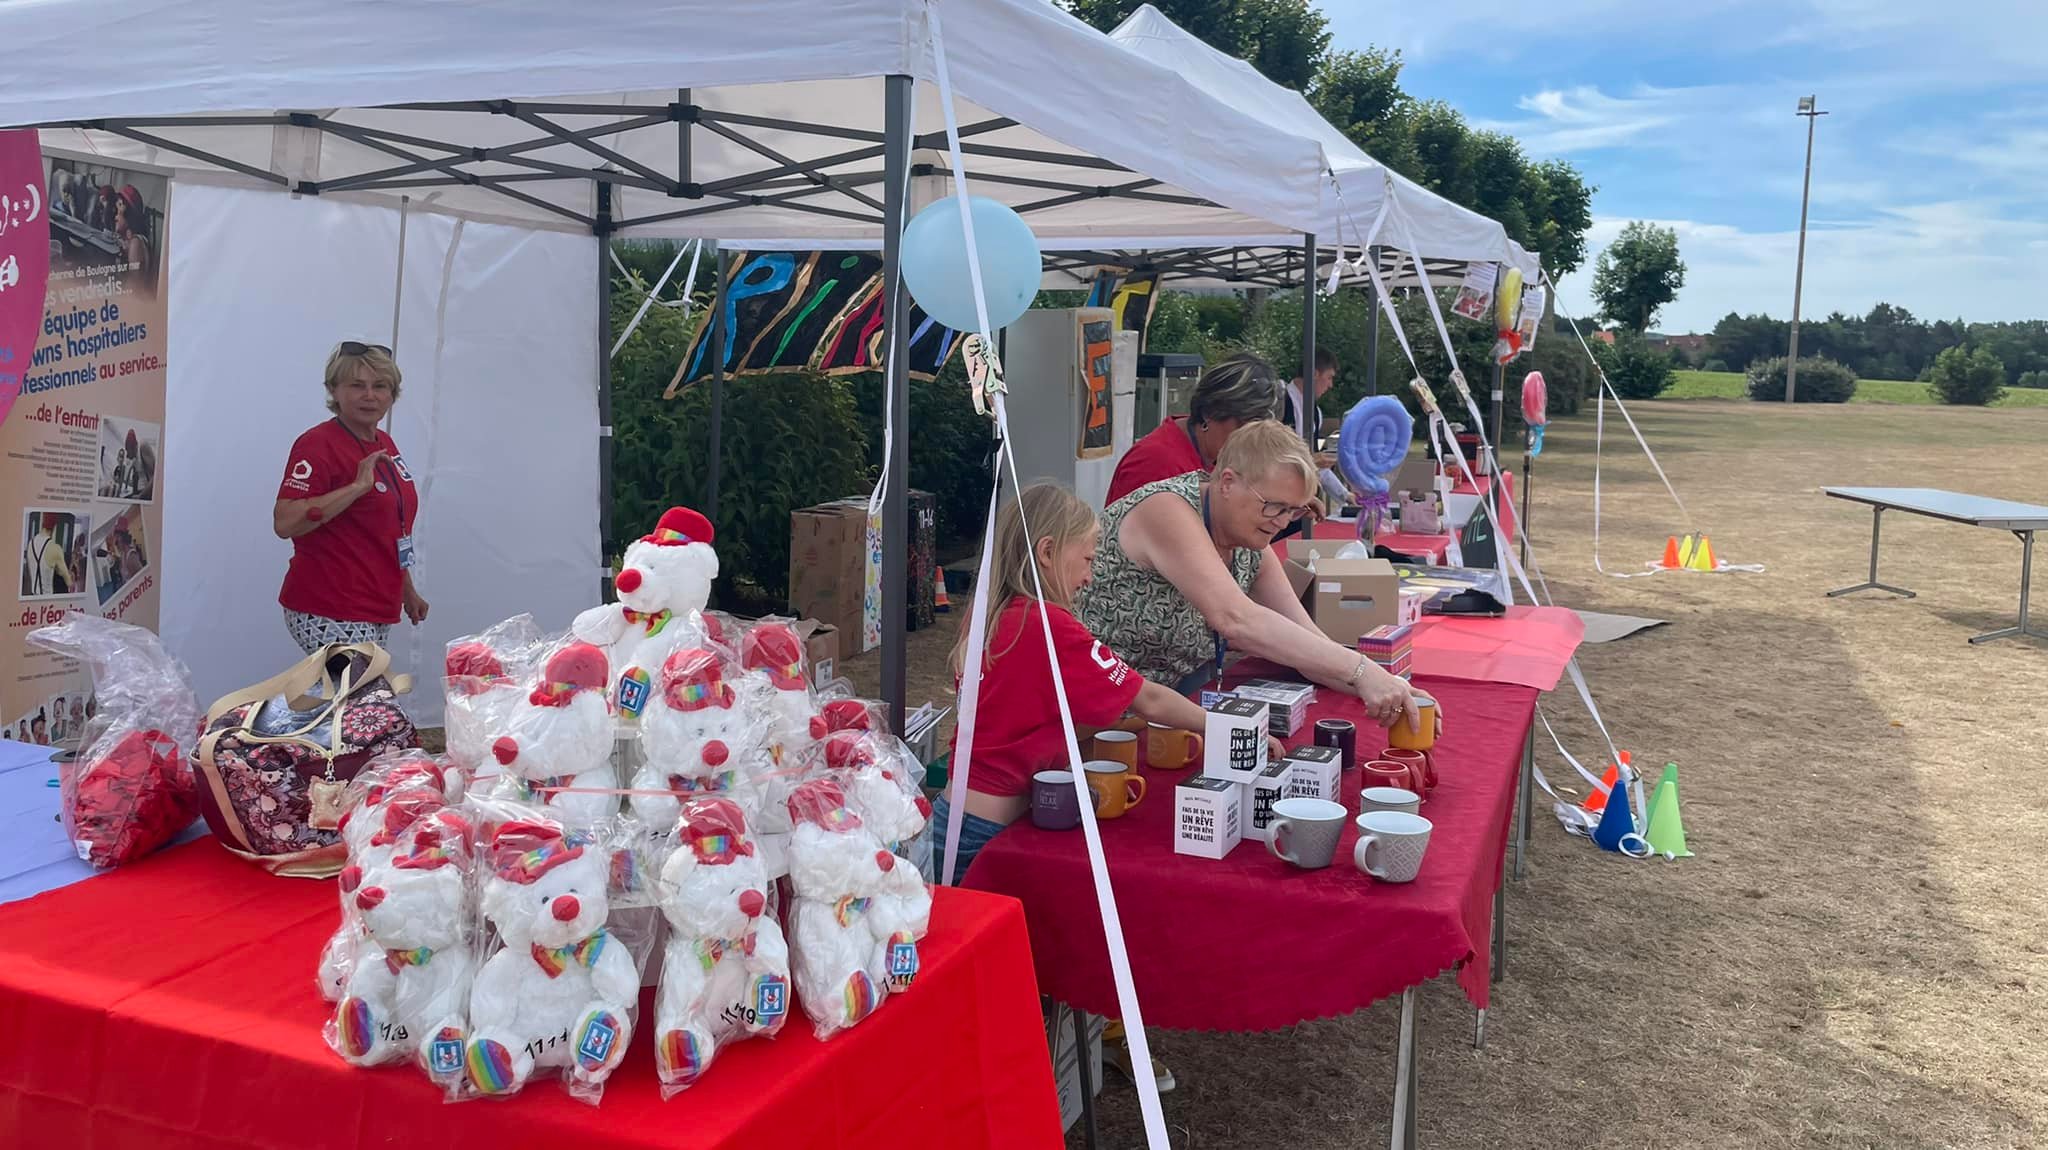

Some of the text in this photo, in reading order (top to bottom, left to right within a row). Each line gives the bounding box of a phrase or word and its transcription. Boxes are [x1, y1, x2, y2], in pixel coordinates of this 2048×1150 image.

[87, 263, 116, 277] Boulogne
[44, 299, 119, 338] équipe de
[32, 343, 62, 367] wns
[67, 323, 147, 358] hospitaliers
[17, 363, 97, 396] fessionnels
[100, 363, 116, 379] au
[120, 352, 167, 376] service...
[55, 405, 100, 430] l'enfant
[118, 575, 153, 618] parents
[1182, 814, 1214, 827] UN RÊVE
